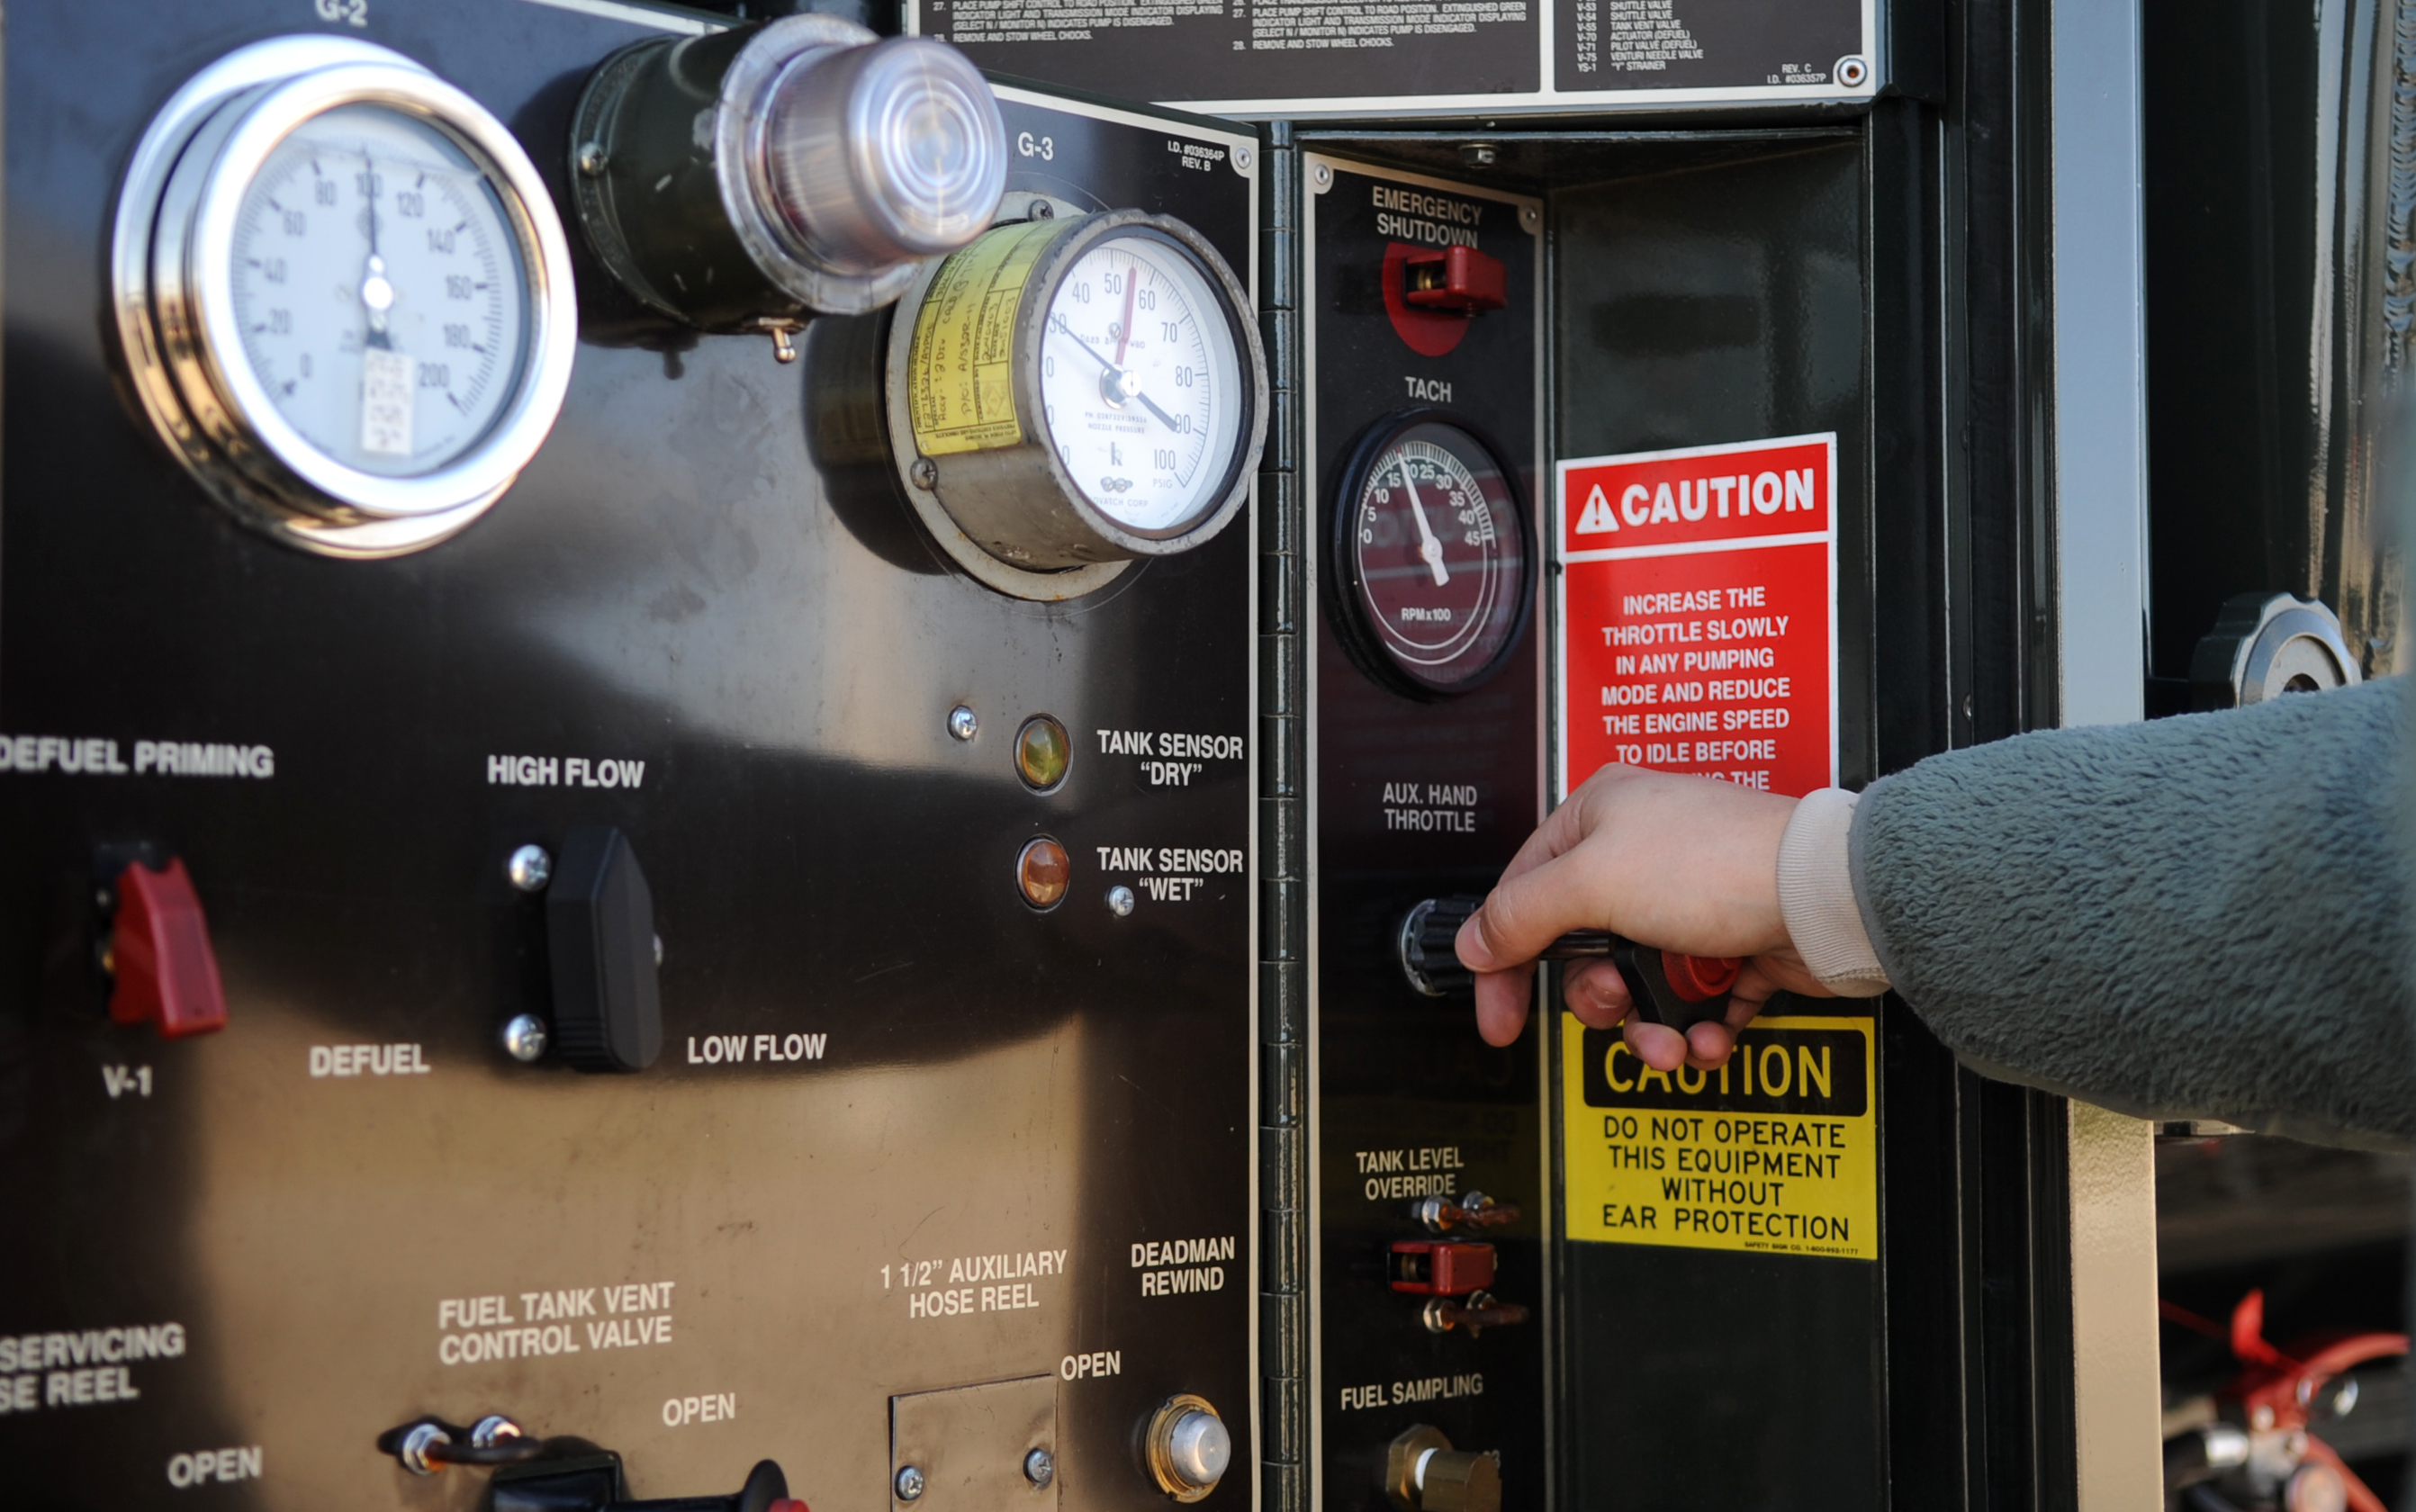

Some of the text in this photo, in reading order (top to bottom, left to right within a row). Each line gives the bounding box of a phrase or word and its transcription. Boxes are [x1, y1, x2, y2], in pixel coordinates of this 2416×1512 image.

[315, 0, 368, 27] G-2
[952, 5, 1223, 20] INDICATOR LIGHT AND TRANSMISSION MODE INDICATOR DISPLAYING
[1252, 40, 1285, 50] REMOVE
[1286, 40, 1304, 49] AND
[1306, 39, 1330, 49] STOW
[1330, 38, 1358, 48] WHEEL
[1359, 37, 1394, 47] CHOCKS.
[1610, 30, 1690, 40] ACTUATOR (DEFUEL)
[1610, 40, 1698, 51] PILOT VALVE (DEFUEL)
[1610, 50, 1704, 61] VENTURI NEEDLE VALVE
[1627, 61, 1666, 71] STRAINER
[1781, 63, 1812, 74] REV. C
[1767, 75, 1780, 84] I.D.
[1017, 131, 1054, 161] G-3
[1167, 140, 1183, 154] I.D.
[1182, 156, 1212, 172] REV. B
[1373, 185, 1483, 225] EMERGENCY
[1377, 212, 1478, 249] SHUTDOWN
[1072, 282, 1090, 304] 40
[1104, 273, 1122, 295] 50
[1138, 289, 1156, 310] 60
[1161, 322, 1178, 343] 70
[419, 362, 450, 389] 200
[1175, 365, 1193, 388] 80
[1405, 375, 1452, 403] TACH
[1174, 414, 1192, 435] 90
[1153, 449, 1176, 471] 100
[1420, 464, 1435, 480] 25
[1153, 478, 1173, 489] PSIG
[1387, 472, 1402, 488] 15
[1436, 473, 1452, 490] 30
[1375, 488, 1390, 504] 10
[1448, 490, 1465, 507] 35
[1621, 467, 1815, 527] CAUTION
[1367, 506, 1377, 522] 5
[1458, 508, 1475, 526] 40
[1363, 528, 1373, 544] 0
[1465, 530, 1481, 546] 45
[1623, 586, 1765, 616] INCREASE THE
[1601, 615, 1789, 646] THROTTLE SLOWLY
[1616, 647, 1774, 675] IN ANY PUMPING
[1601, 677, 1791, 706] MODE AND REDUCE
[1602, 707, 1790, 735] THE ENGINE SPEED
[0, 735, 275, 778] DEFUEL PRIMING
[1096, 729, 1243, 760] TANK SENSOR
[1616, 738, 1776, 764] TO IDLE BEFORE
[487, 754, 645, 788] HIGH FLOW
[1730, 770, 1771, 790] THE
[1383, 782, 1478, 806] AUX. HAND
[1384, 808, 1476, 832] THROTTLE
[1096, 846, 1243, 873] TANK SENSOR
[310, 1044, 431, 1077] DEFUEL
[688, 1033, 827, 1064] LOW FLOW
[103, 1066, 153, 1098] V-1
[1604, 1115, 1846, 1148] DO NOT OPERATE
[1357, 1147, 1465, 1174] TANK LEVEL
[1609, 1145, 1842, 1179] THIS EQUIPMENT
[1365, 1173, 1456, 1201] OVERRIDE
[1662, 1176, 1785, 1207] WITHOUT
[1603, 1203, 1850, 1242] EAR PROTECTION
[1131, 1237, 1235, 1268] DEADMAN
[880, 1266, 889, 1289] 1
[949, 1249, 1068, 1283] AUXILIARY
[1141, 1266, 1225, 1297] REWIND
[439, 1282, 676, 1329] FUEL TANK VENT
[909, 1282, 1040, 1318] HOSE REEL
[0, 1322, 186, 1373] SERVICING
[439, 1316, 672, 1365] CONTROL VALVE
[1060, 1350, 1121, 1381] OPEN
[46, 1365, 140, 1408] REEL
[1340, 1372, 1484, 1410] FUEL SAMPLING
[663, 1392, 735, 1426] OPEN
[167, 1445, 263, 1488] OPEN
